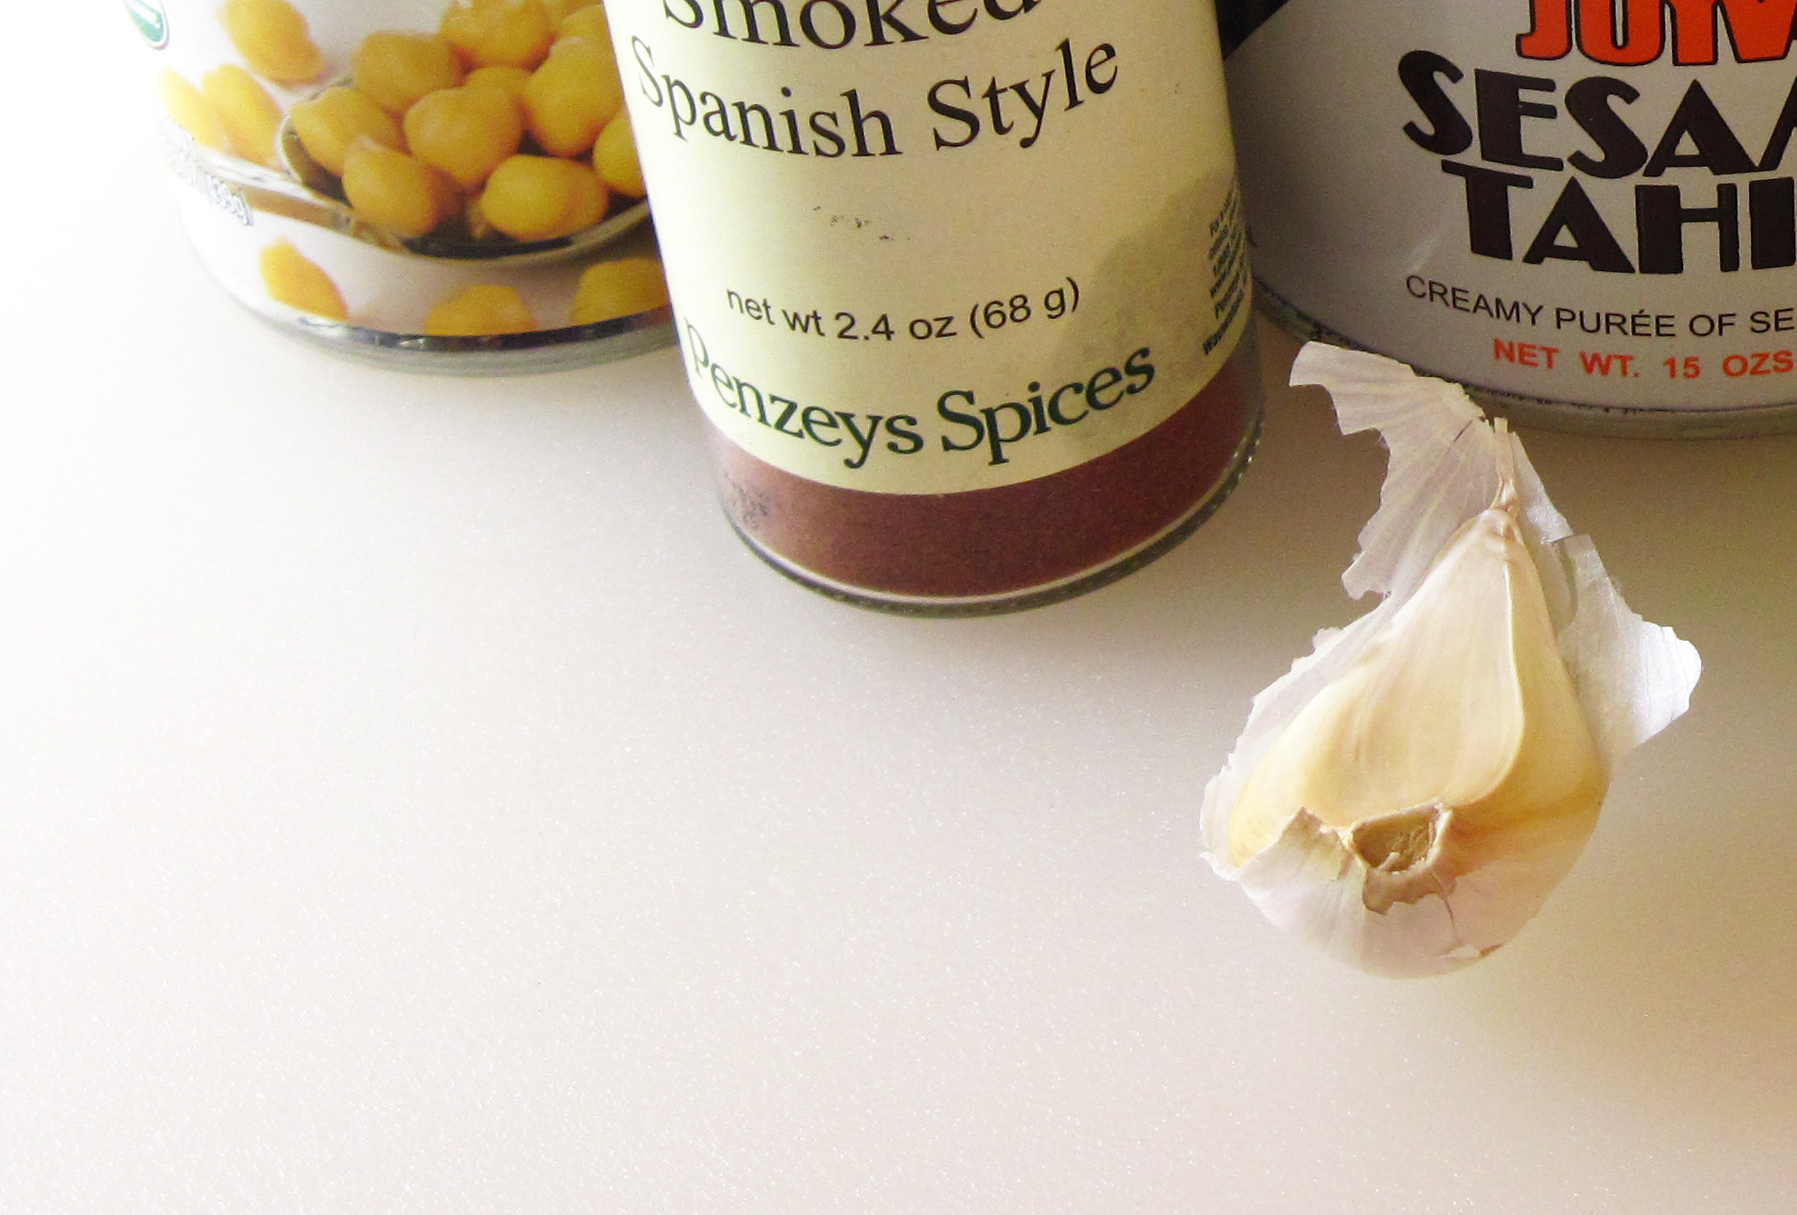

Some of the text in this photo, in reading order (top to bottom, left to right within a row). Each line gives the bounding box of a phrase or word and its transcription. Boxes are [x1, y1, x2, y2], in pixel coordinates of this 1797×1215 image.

[630, 36, 1119, 158] Spanish Style
[726, 276, 1081, 342] net wt 2.4 oz (68 g)
[1405, 274, 1545, 329] CREAMY
[1555, 308, 1677, 339] PURÉE
[1688, 312, 1738, 337] OF
[1492, 338, 1561, 372] NET
[1578, 351, 1640, 380] WT.
[1662, 357, 1702, 380] 15
[685, 317, 1156, 469] Penzeys Spices
